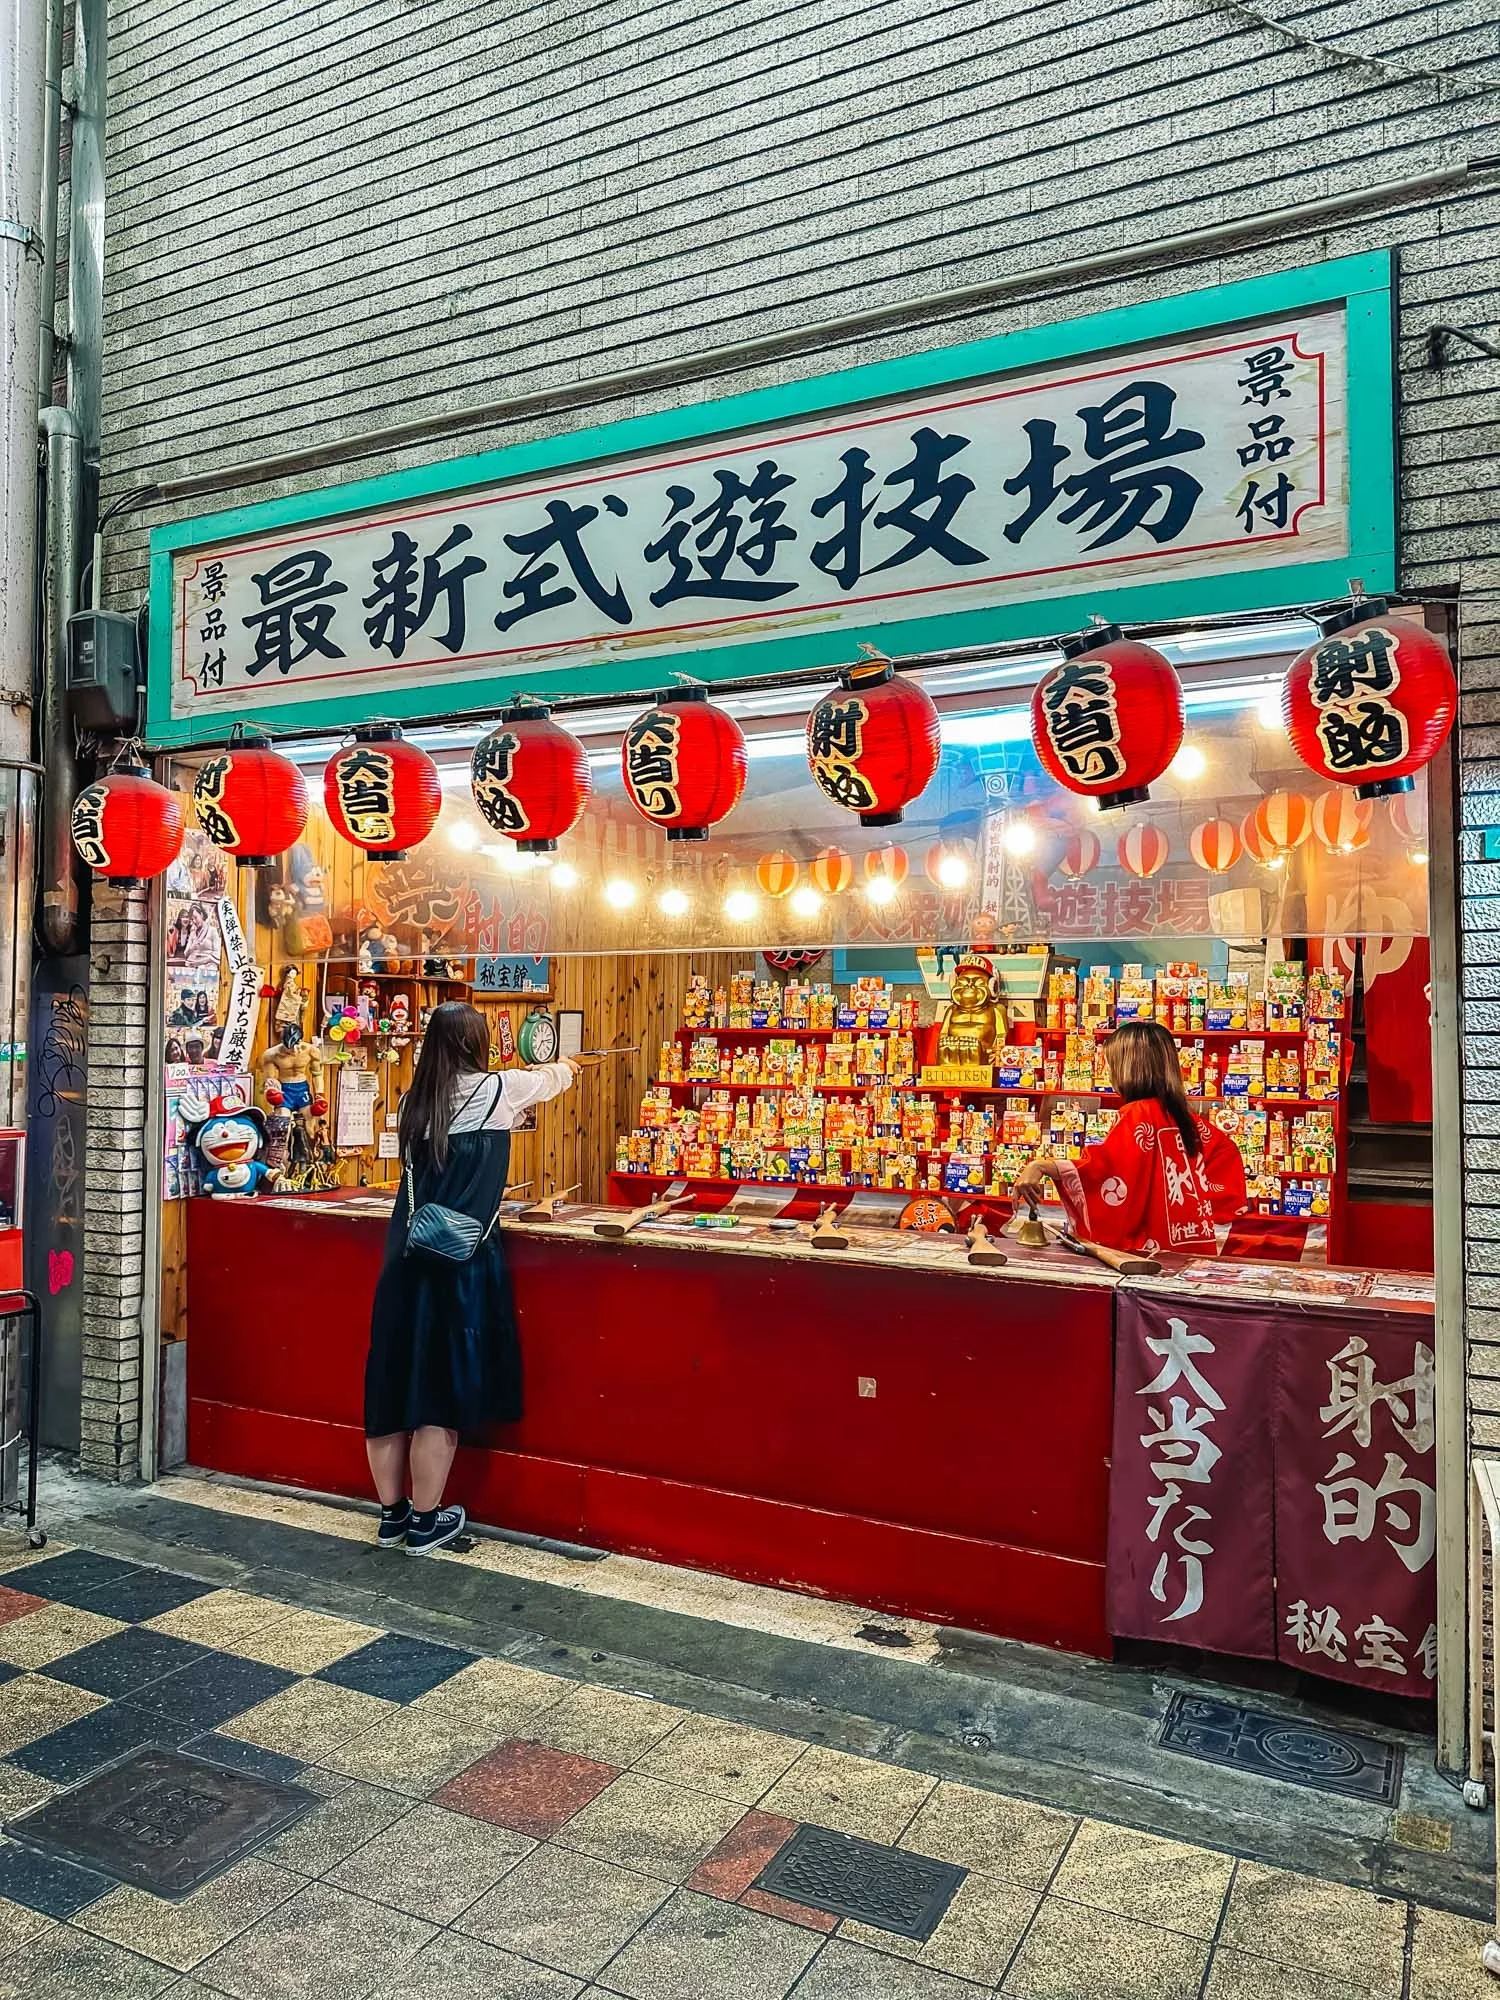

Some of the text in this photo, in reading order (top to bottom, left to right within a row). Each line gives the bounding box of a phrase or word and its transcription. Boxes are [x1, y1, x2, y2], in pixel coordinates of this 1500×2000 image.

[1236, 347, 1295, 535] 景品付
[242, 381, 1207, 677] 最新式遊技場
[199, 561, 228, 688] 景品付
[221, 900, 247, 970] 実弾禁止
[480, 962, 529, 989] 秘宝館
[226, 969, 258, 1073] 空打ち厳禁
[925, 1070, 989, 1082] BILLIKEN
[1136, 1318, 1227, 1623] 大当たり
[1314, 1335, 1436, 1574] 射的
